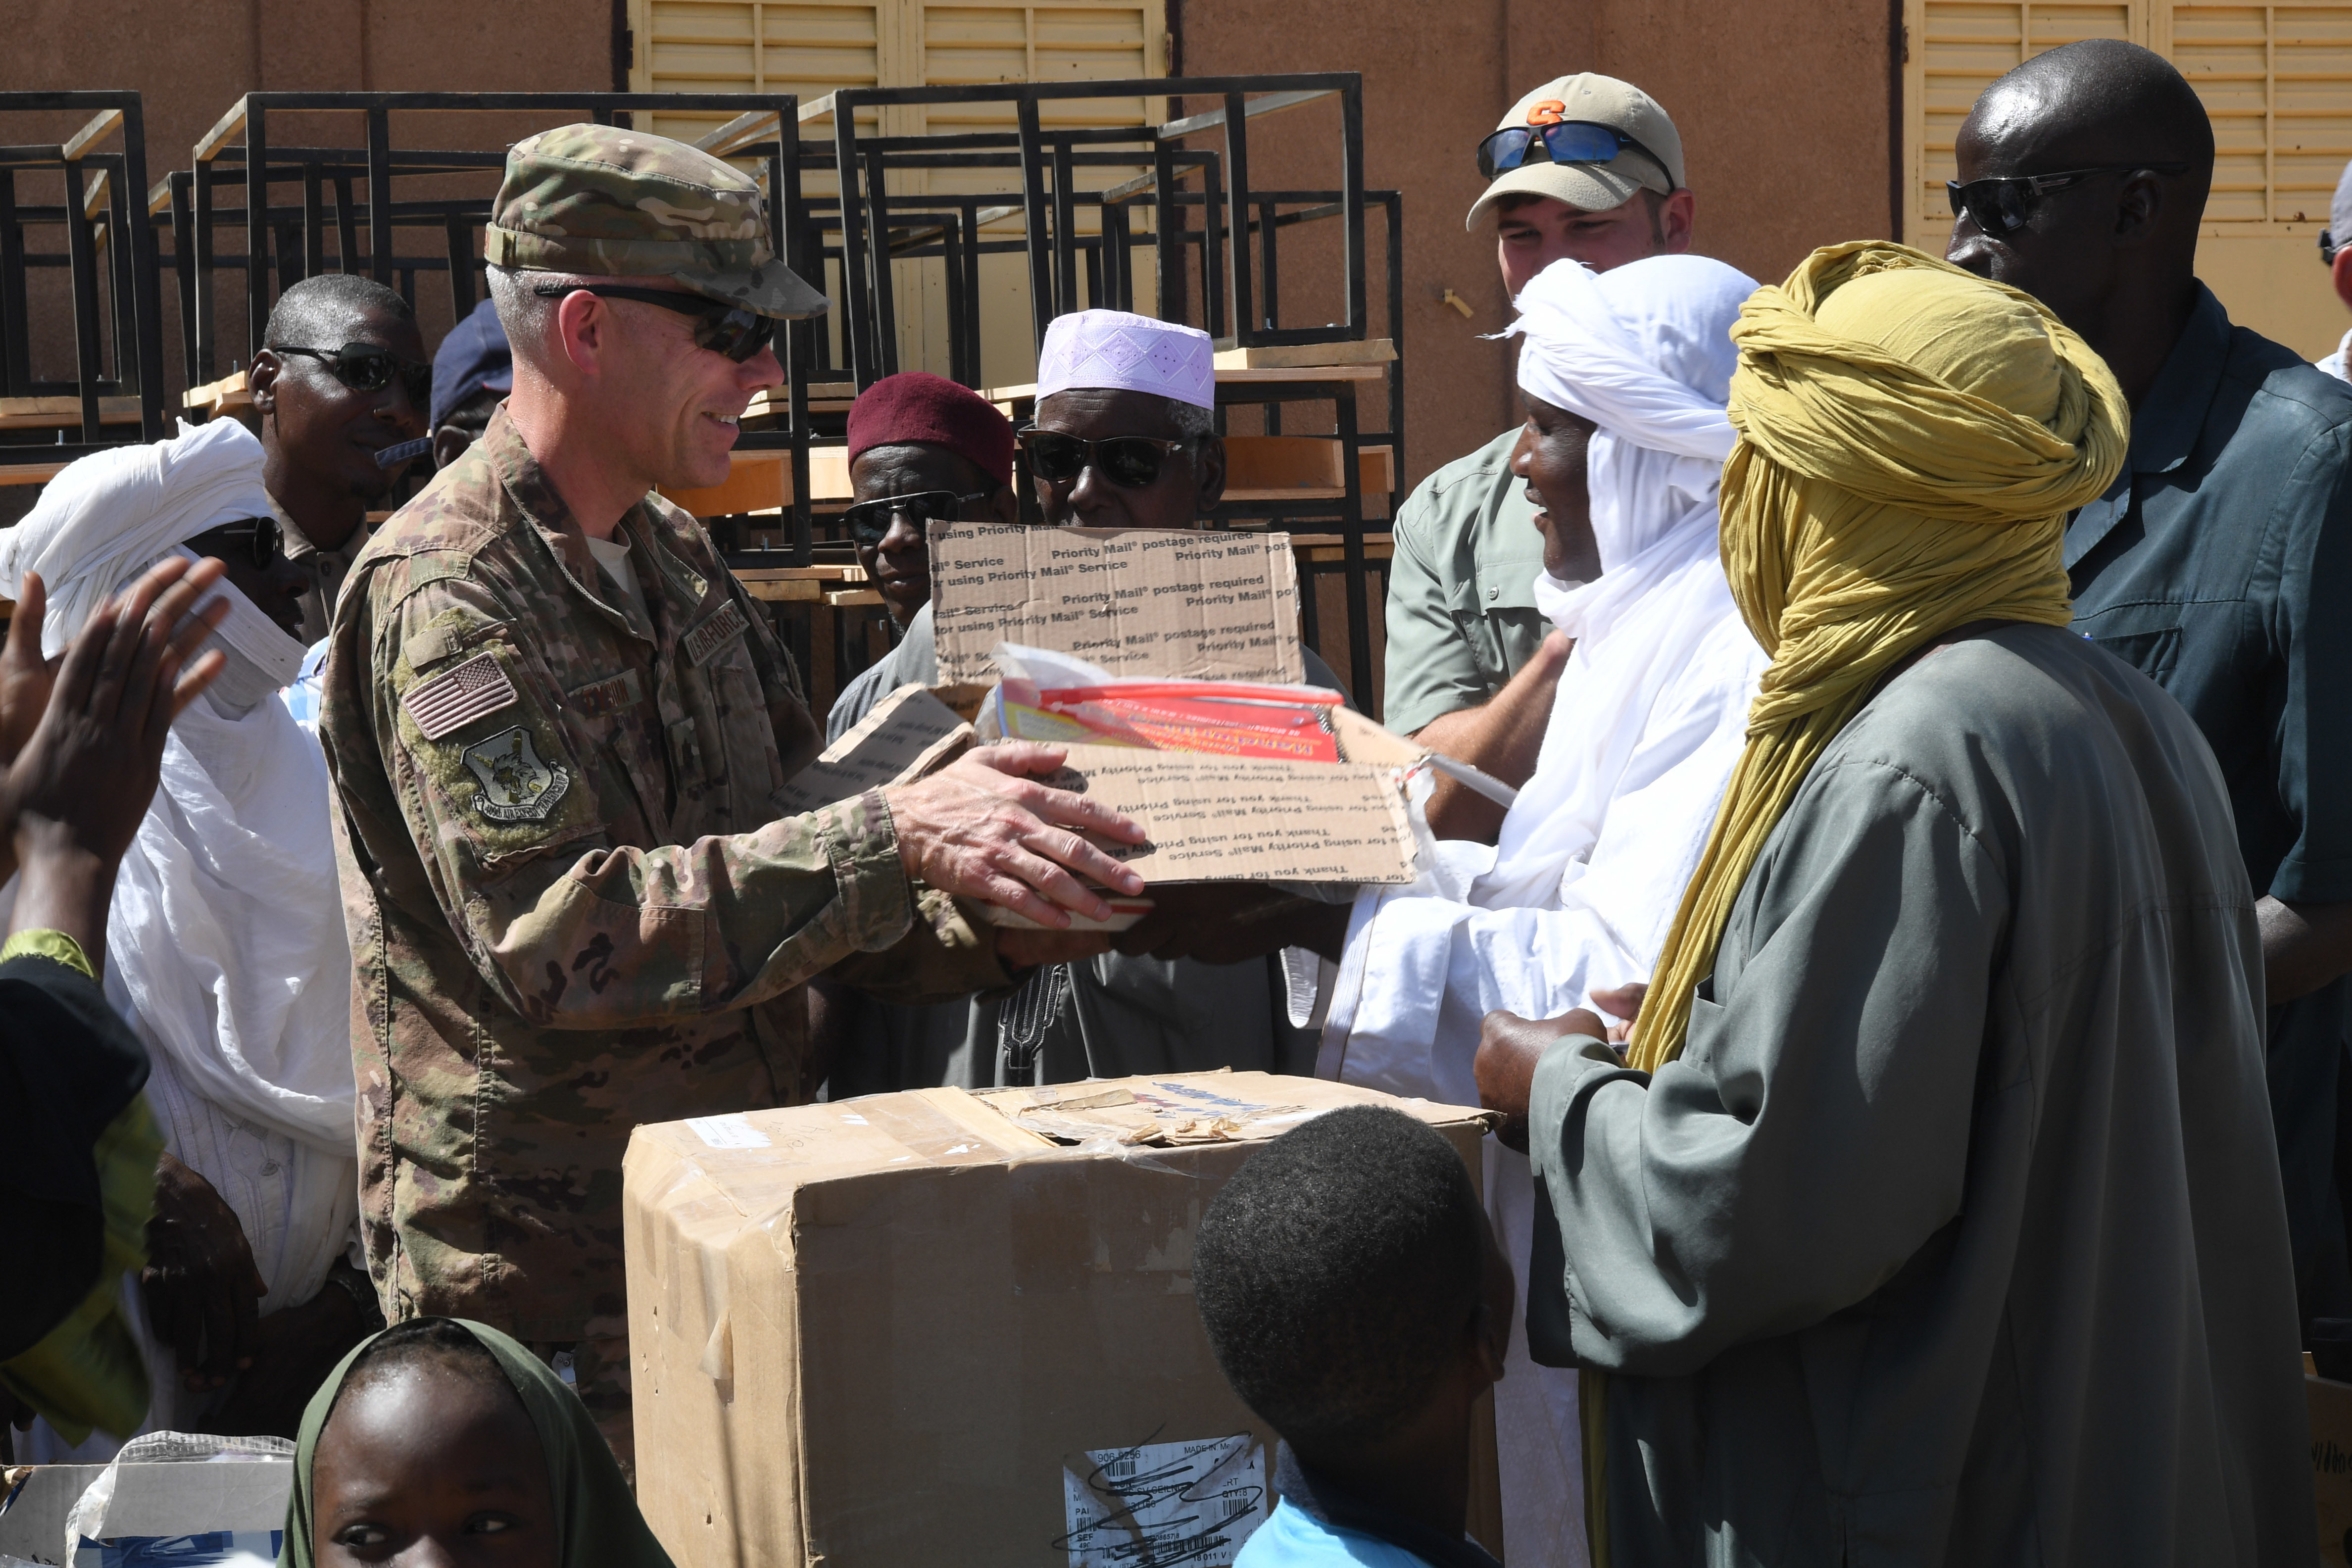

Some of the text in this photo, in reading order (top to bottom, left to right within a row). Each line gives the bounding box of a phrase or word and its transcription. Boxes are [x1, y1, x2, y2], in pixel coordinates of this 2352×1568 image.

[938, 530, 974, 539] using
[978, 525, 1026, 536] Priority
[1052, 547, 1100, 559] Priority
[1142, 538, 1194, 551] postage
[1198, 533, 1253, 543] required
[1176, 550, 1223, 561] Priority
[955, 558, 1004, 570] Service
[948, 576, 984, 586] using
[988, 570, 1036, 582] Priority
[1078, 561, 1128, 573] Service
[1062, 592, 1111, 605] Priority
[1153, 583, 1204, 596] postage
[1210, 575, 1264, 589] required
[1186, 594, 1234, 607] Priority
[965, 604, 1014, 615] Service
[959, 622, 995, 632] using
[999, 615, 1047, 627] Priority
[1089, 606, 1138, 619] Service
[704, 606, 745, 644] FORCE
[1073, 639, 1121, 651] Priority
[1164, 629, 1216, 642] postage
[1221, 620, 1274, 635] required
[1197, 639, 1245, 652] Priority
[1100, 651, 1149, 663] Service
[583, 679, 630, 715] TYSON
[1117, 802, 1169, 813] Priority
[1153, 811, 1206, 822] Service
[1258, 829, 1282, 838] you
[1287, 829, 1330, 837] Thank
[1188, 835, 1228, 845] using
[1323, 839, 1362, 847] using
[1367, 838, 1387, 846] for
[1132, 839, 1185, 853] Priority
[1269, 842, 1320, 851] Priority
[1169, 849, 1223, 861] Service
[1249, 871, 1270, 880] for
[1274, 867, 1299, 876] you
[1303, 866, 1348, 876] Thank
[1184, 1445, 1206, 1454] MADE
